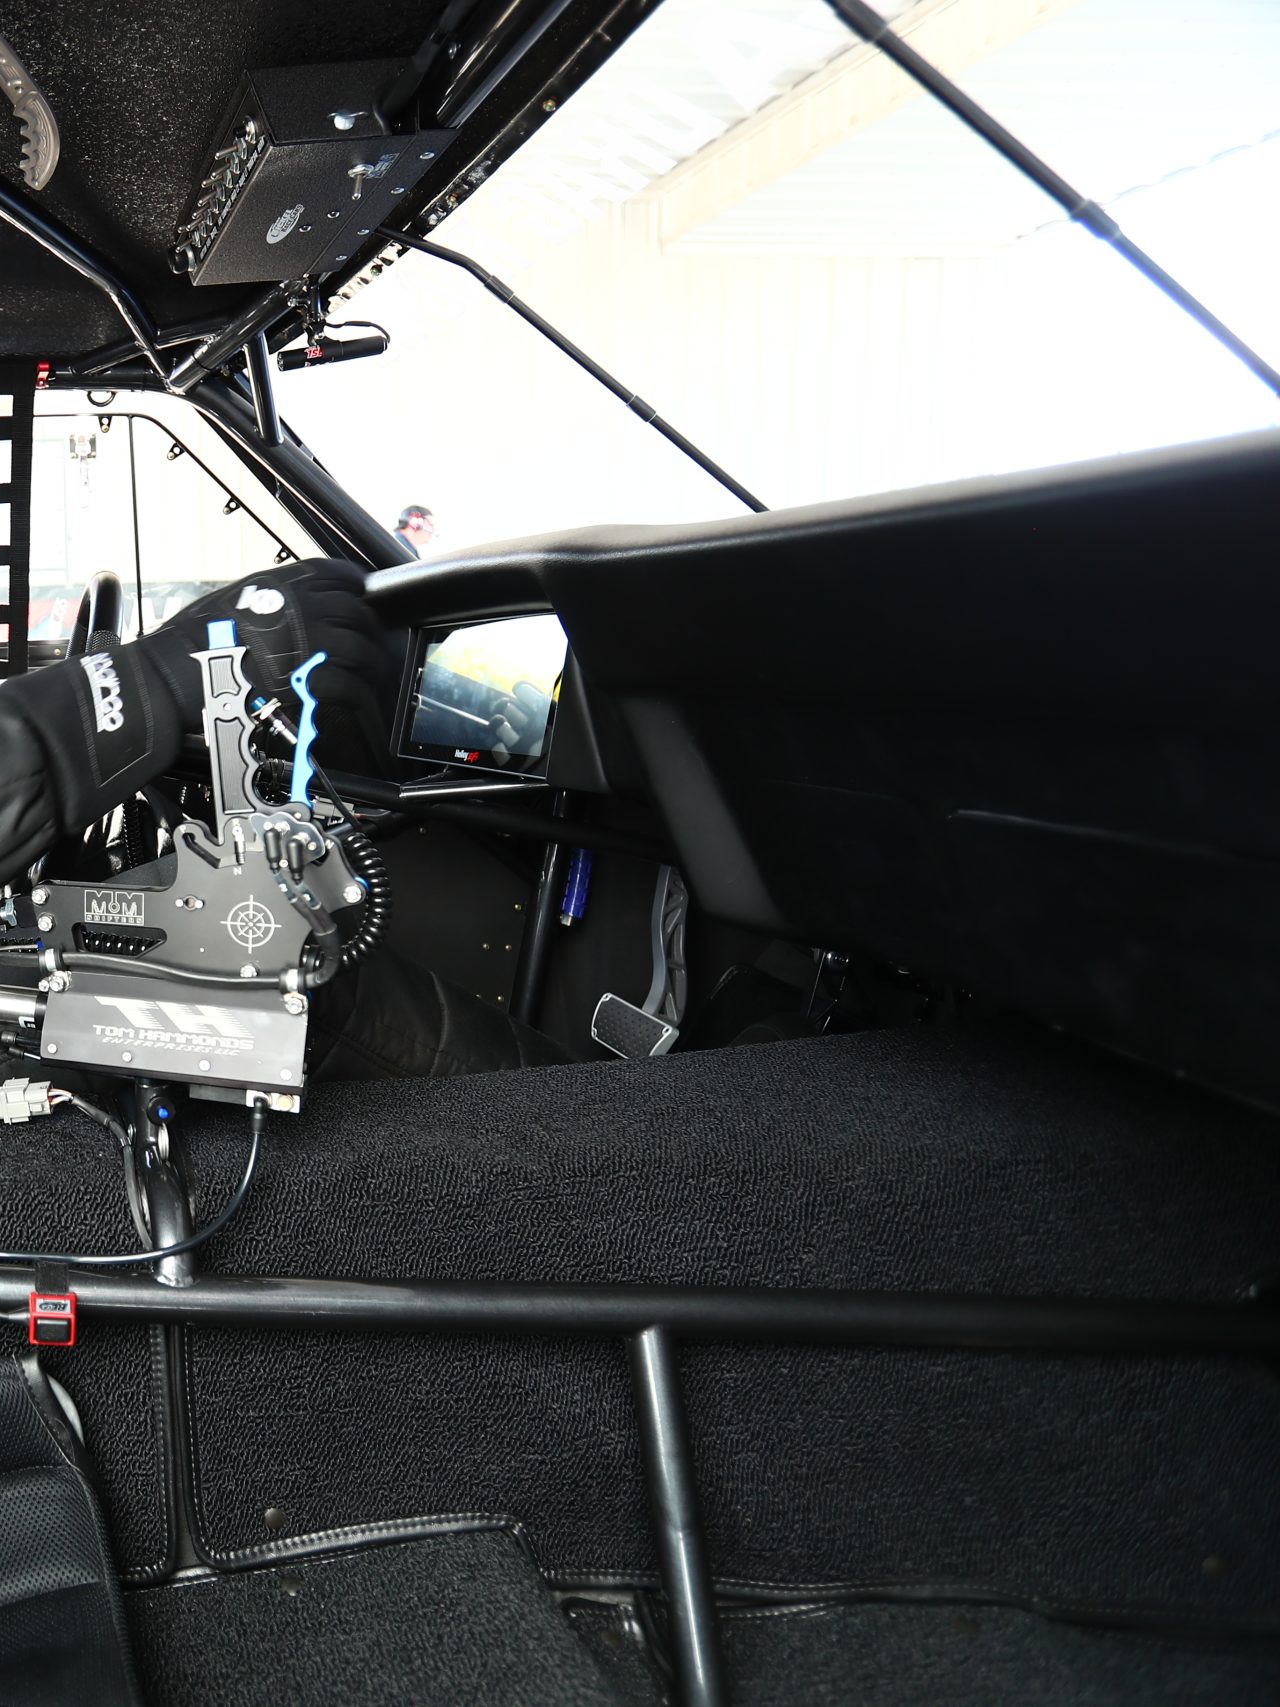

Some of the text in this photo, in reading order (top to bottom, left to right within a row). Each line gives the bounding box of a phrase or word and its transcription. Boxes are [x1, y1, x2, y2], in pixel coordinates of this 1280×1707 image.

[233, 866, 242, 876] N
[86, 914, 143, 925] SHIFTERS
[94, 996, 255, 1039] TH
[93, 1024, 256, 1050] TOM HAMMONDS
[102, 1036, 241, 1056] ENTERPRISES LLC
